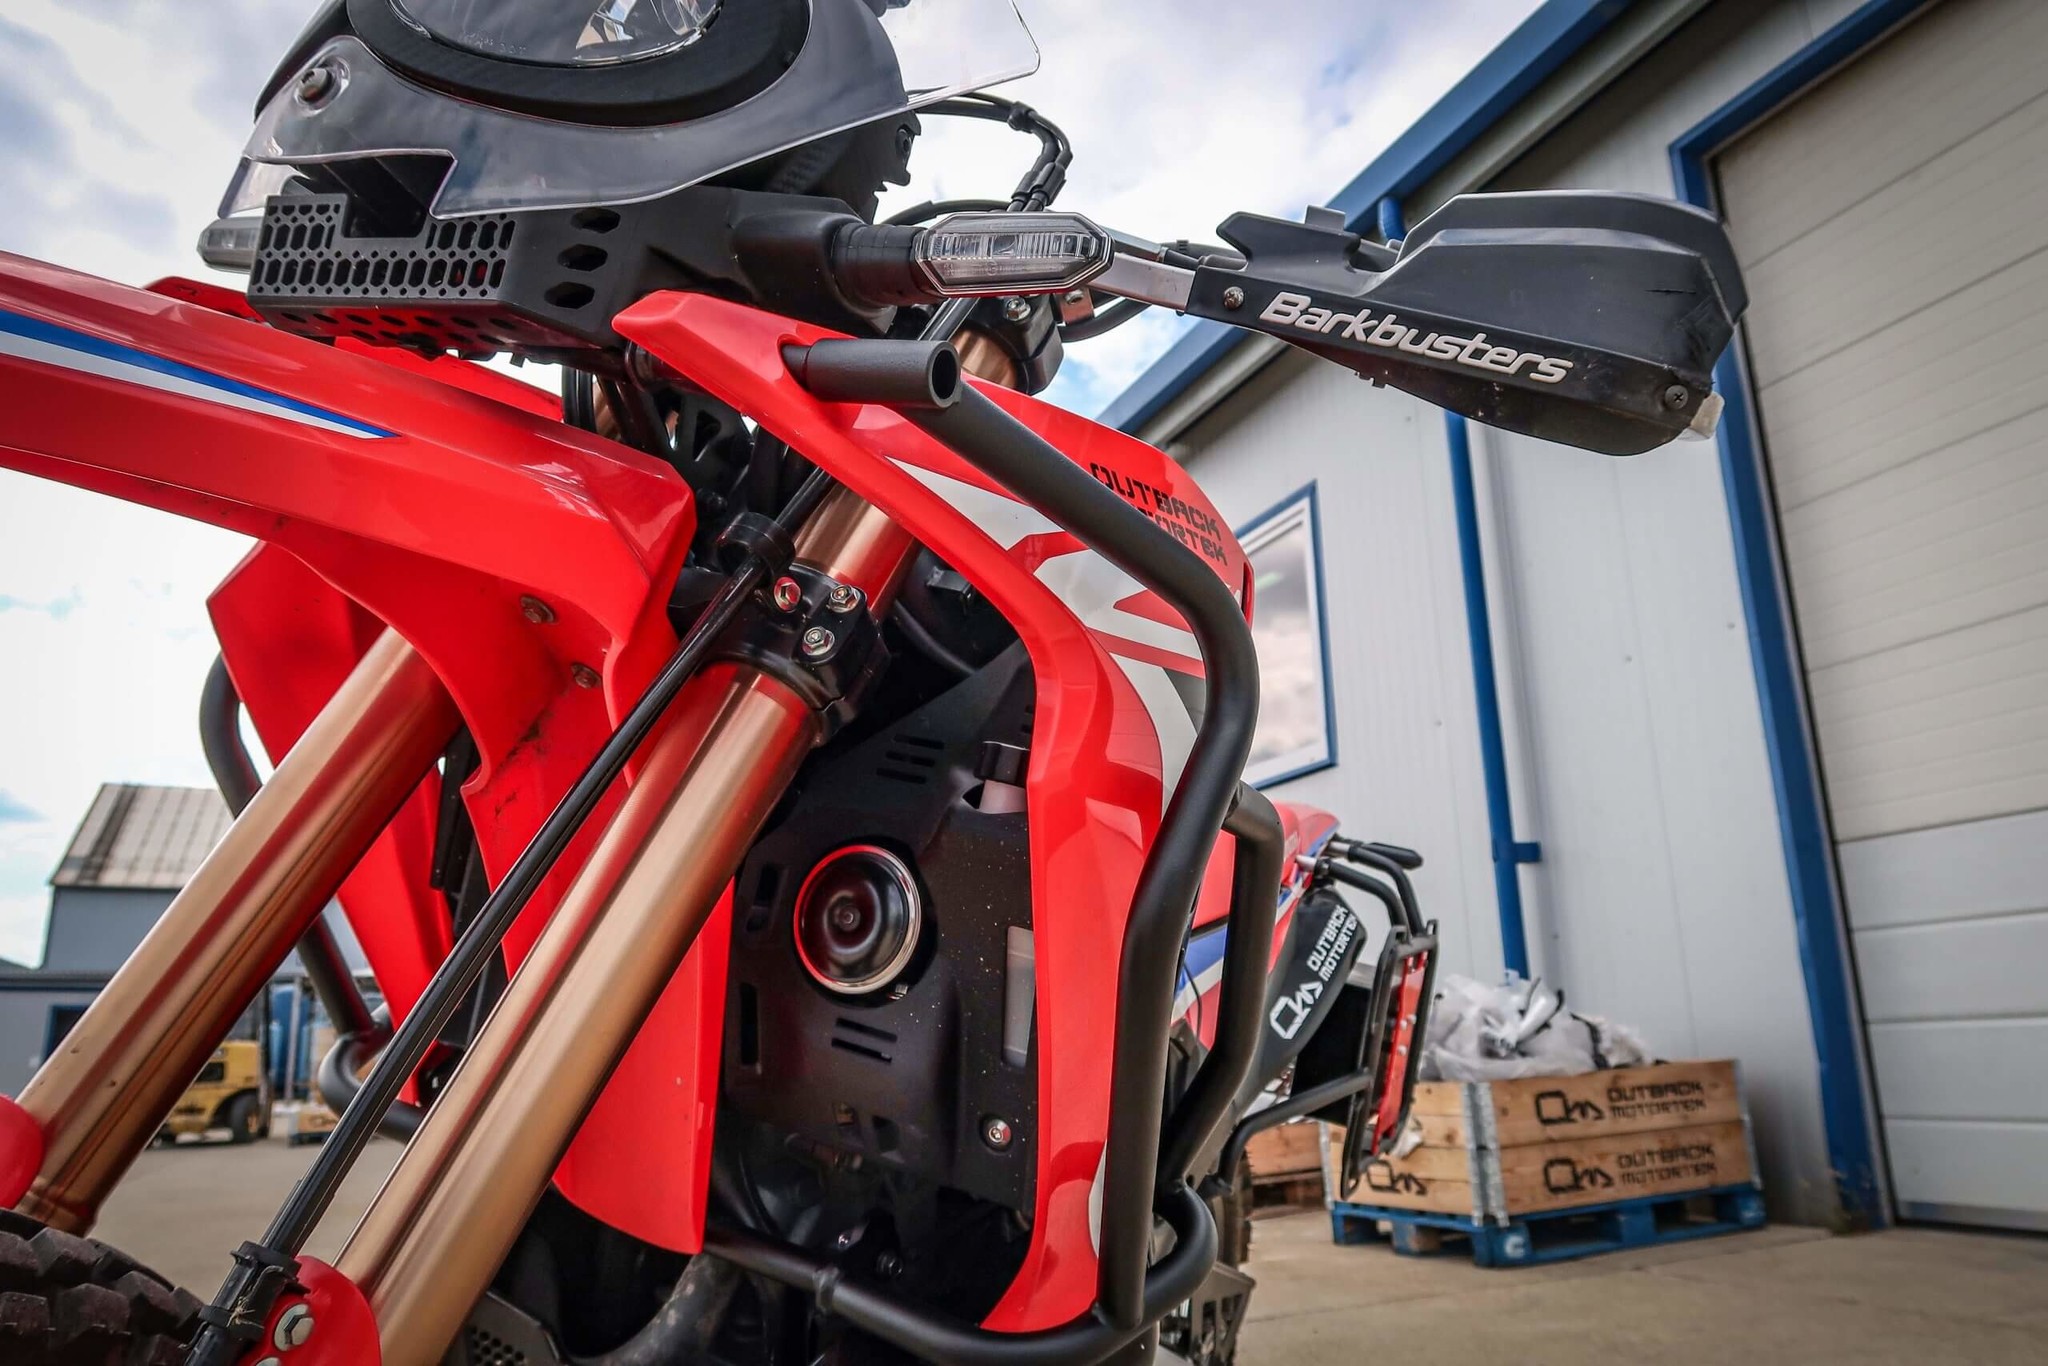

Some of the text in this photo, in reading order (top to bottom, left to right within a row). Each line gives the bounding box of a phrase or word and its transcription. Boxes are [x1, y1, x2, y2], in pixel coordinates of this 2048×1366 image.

[1259, 291, 1574, 384] Barkbusters
[1090, 462, 1222, 541] OUTBACK
[1306, 904, 1349, 972] OUTBACK
[1318, 912, 1358, 982] MOTORTEK
[1607, 1081, 1704, 1102] OUTBACK
[1609, 1098, 1706, 1119] MOTORTEK
[1617, 1143, 1716, 1169] OUTBACK
[1620, 1161, 1718, 1186] MOTORTEK
